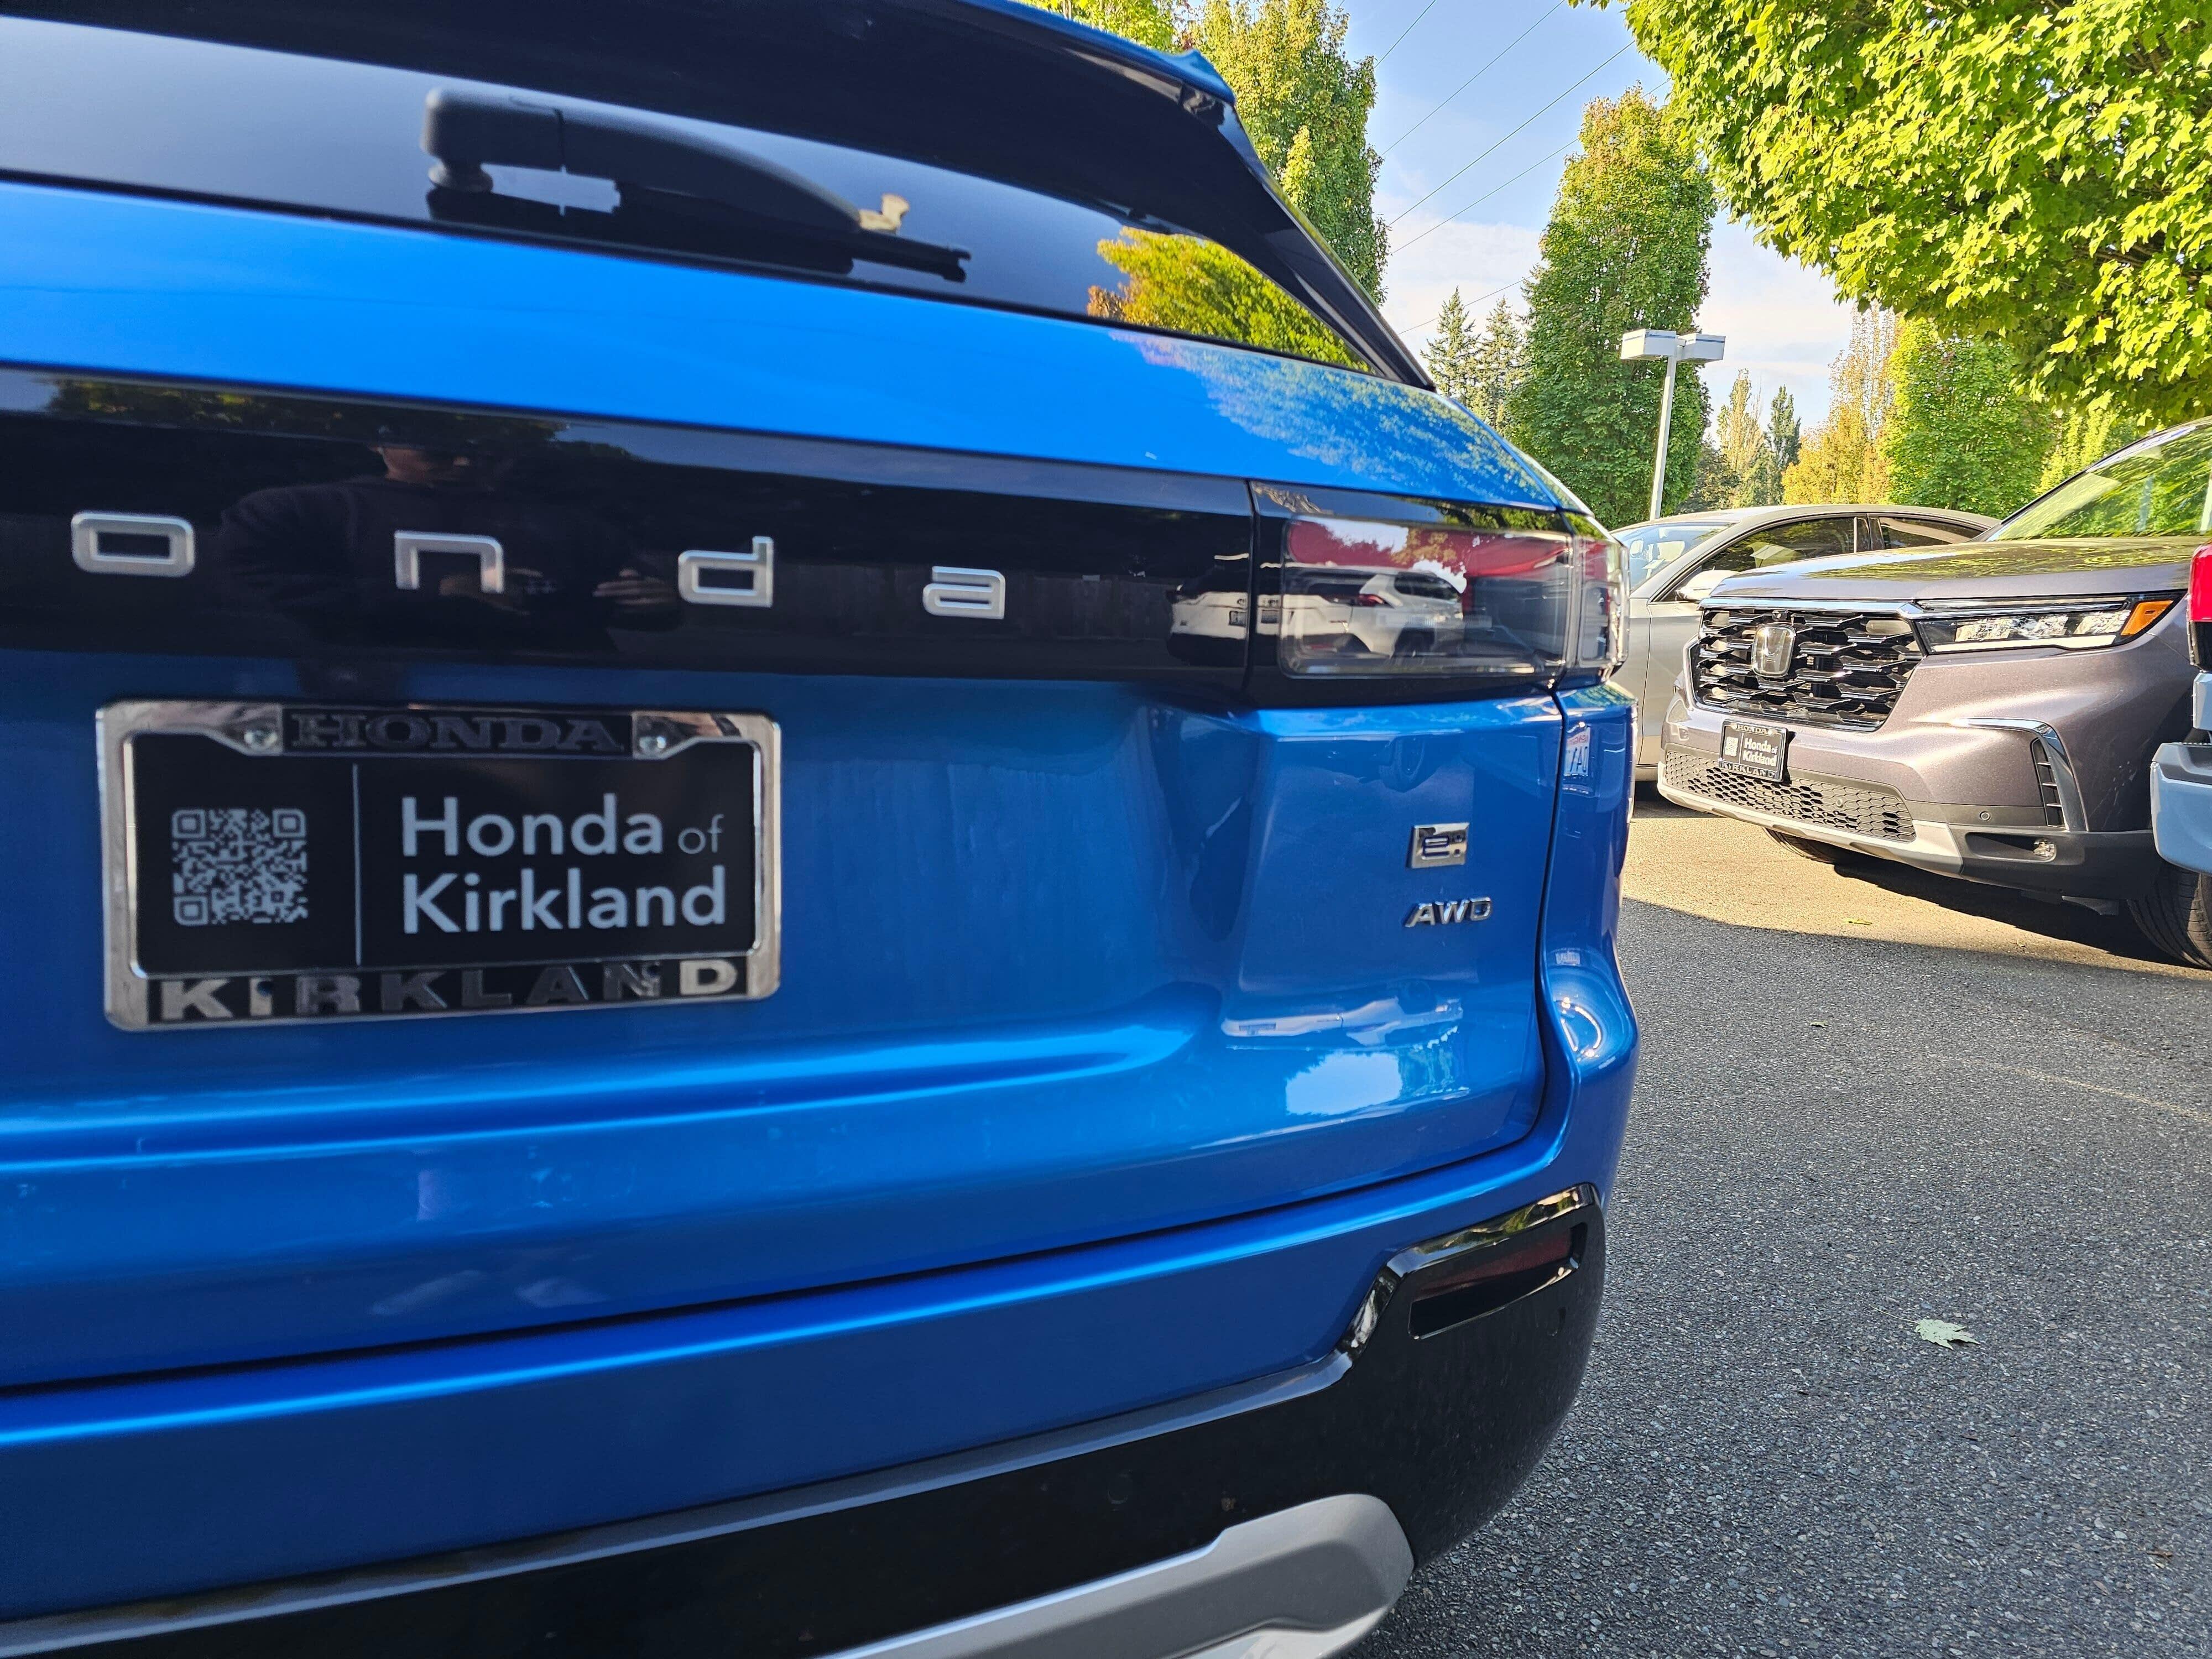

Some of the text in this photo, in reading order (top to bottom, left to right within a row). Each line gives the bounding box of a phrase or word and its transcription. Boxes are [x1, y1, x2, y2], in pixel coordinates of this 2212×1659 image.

[290, 713, 625, 753] HONDA
[1737, 725, 1768, 734] HONDA
[1744, 738, 1771, 752] Honda
[1721, 763, 1775, 778] KIRKLAND
[1743, 750, 1777, 766] Kirkland
[402, 794, 724, 856] Honda of
[404, 867, 726, 933] Kirkland
[1405, 896, 1491, 928] AWD
[160, 959, 738, 1020] KIRKLAND
